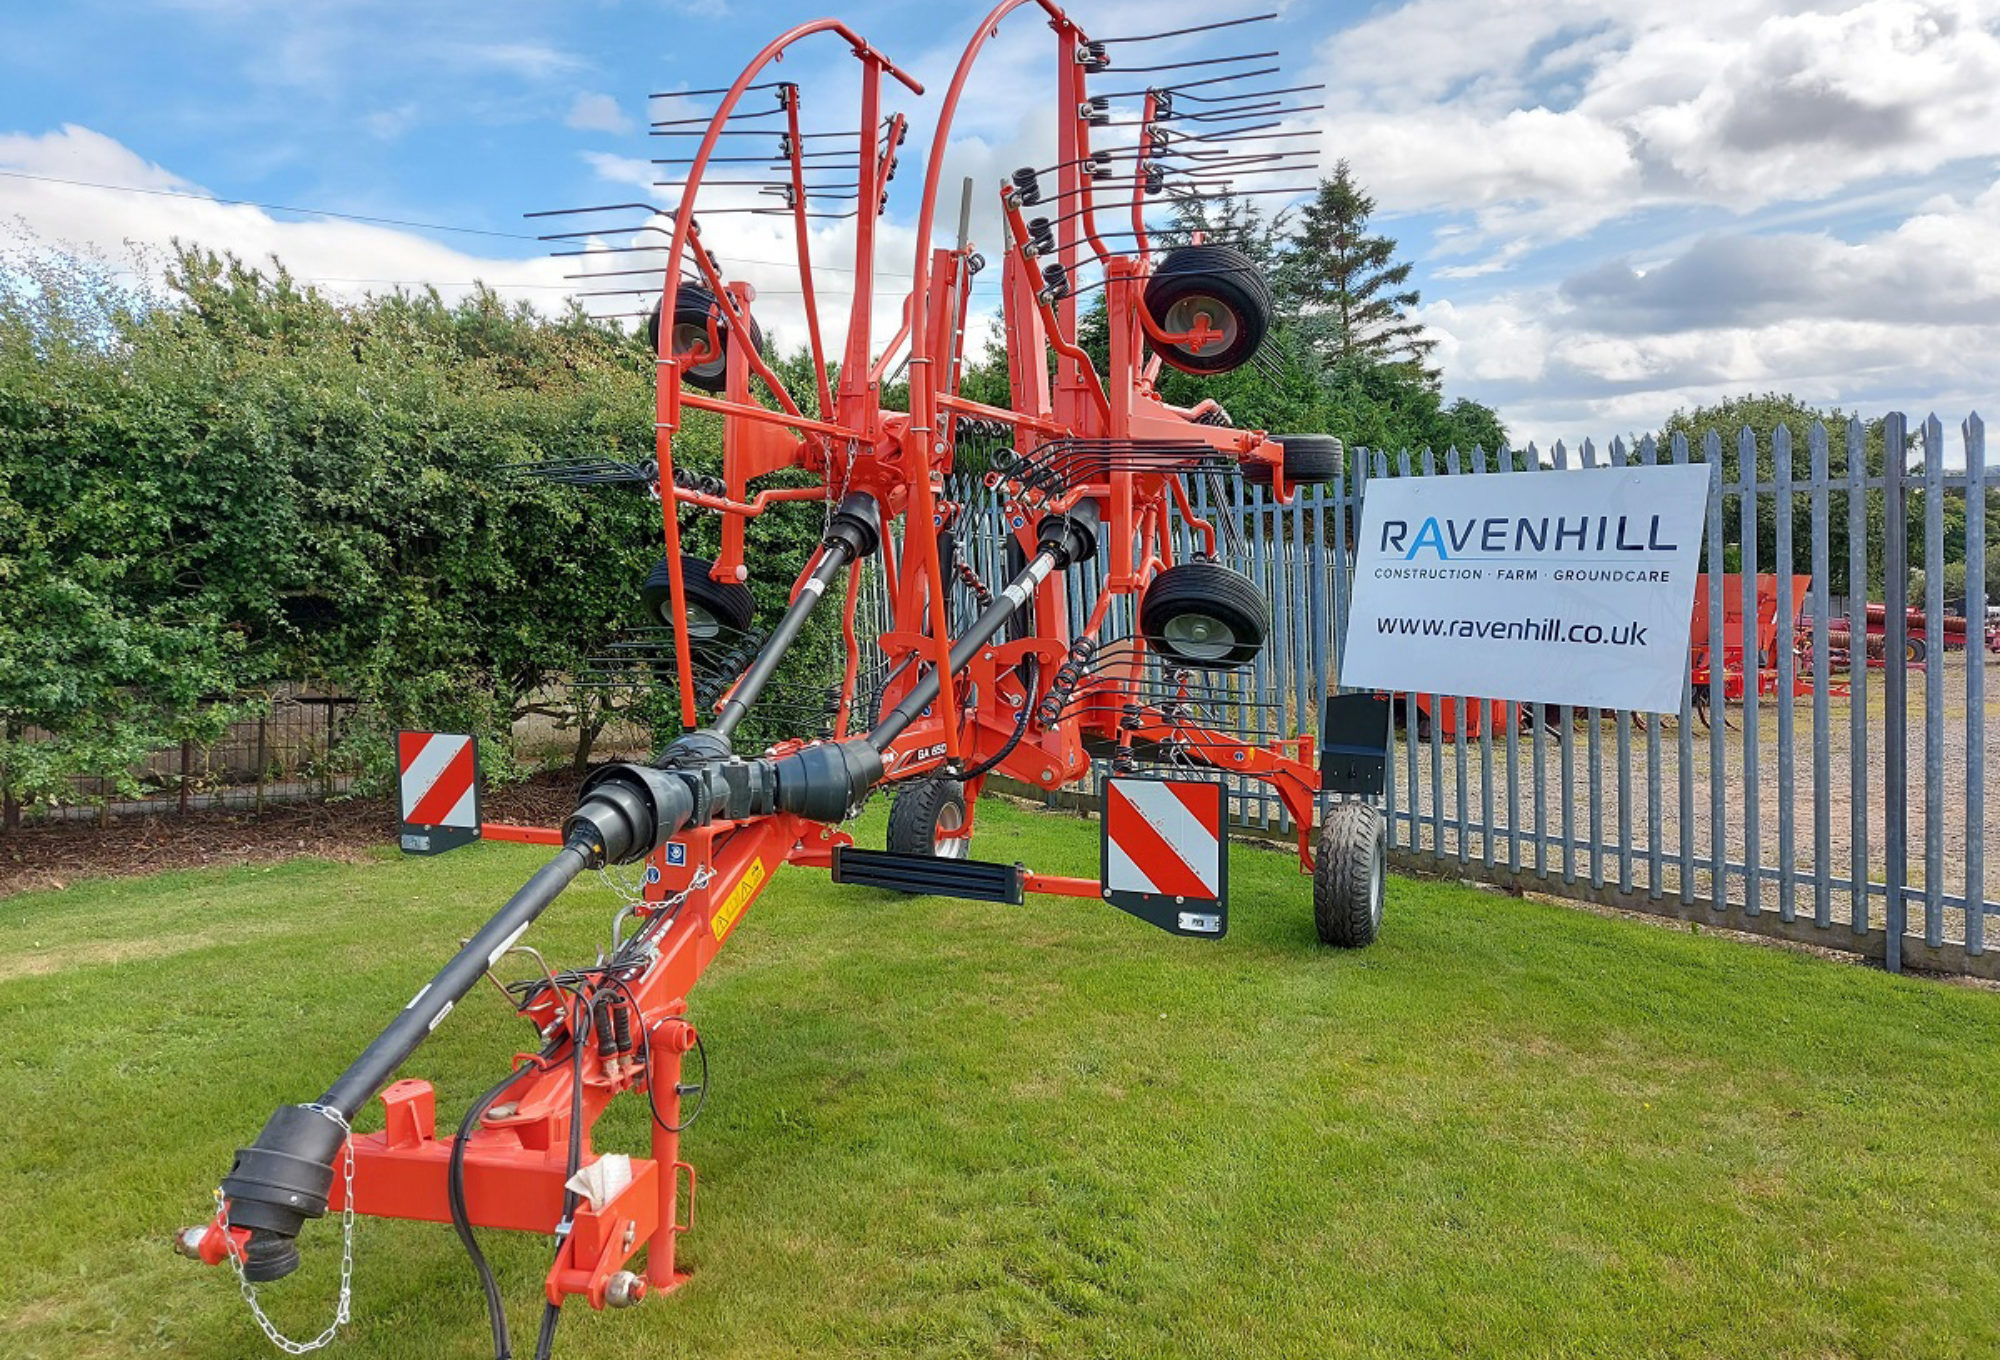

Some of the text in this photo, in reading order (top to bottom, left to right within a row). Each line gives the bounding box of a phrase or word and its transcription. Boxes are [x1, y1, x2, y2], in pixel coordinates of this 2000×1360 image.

[1380, 515, 1677, 560] RAVENHILL
[1374, 567, 1670, 583] CONSTRUCTION FARM GROUNDCARE
[1377, 617, 1648, 646] www.ravenhill.co.uk
